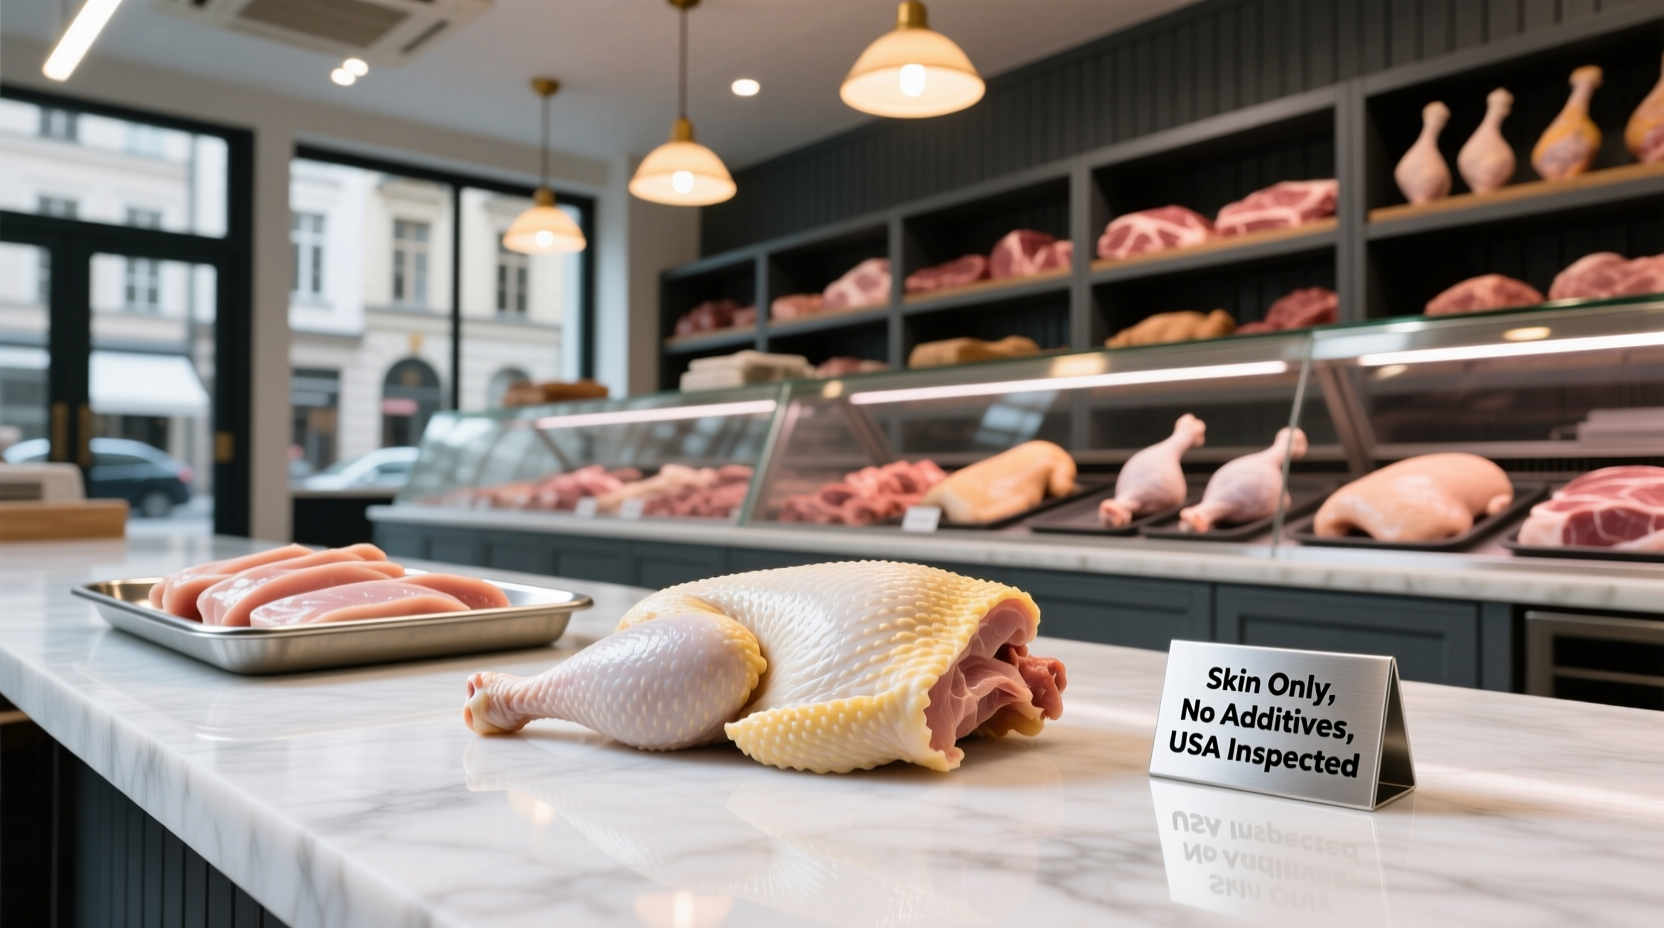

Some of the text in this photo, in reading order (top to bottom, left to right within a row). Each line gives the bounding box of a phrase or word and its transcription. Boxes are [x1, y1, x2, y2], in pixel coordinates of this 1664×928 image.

[1206, 666, 1336, 707] Skin Only,
[1180, 698, 1355, 746] No Additives,
[1169, 730, 1361, 779] USA Inspected
